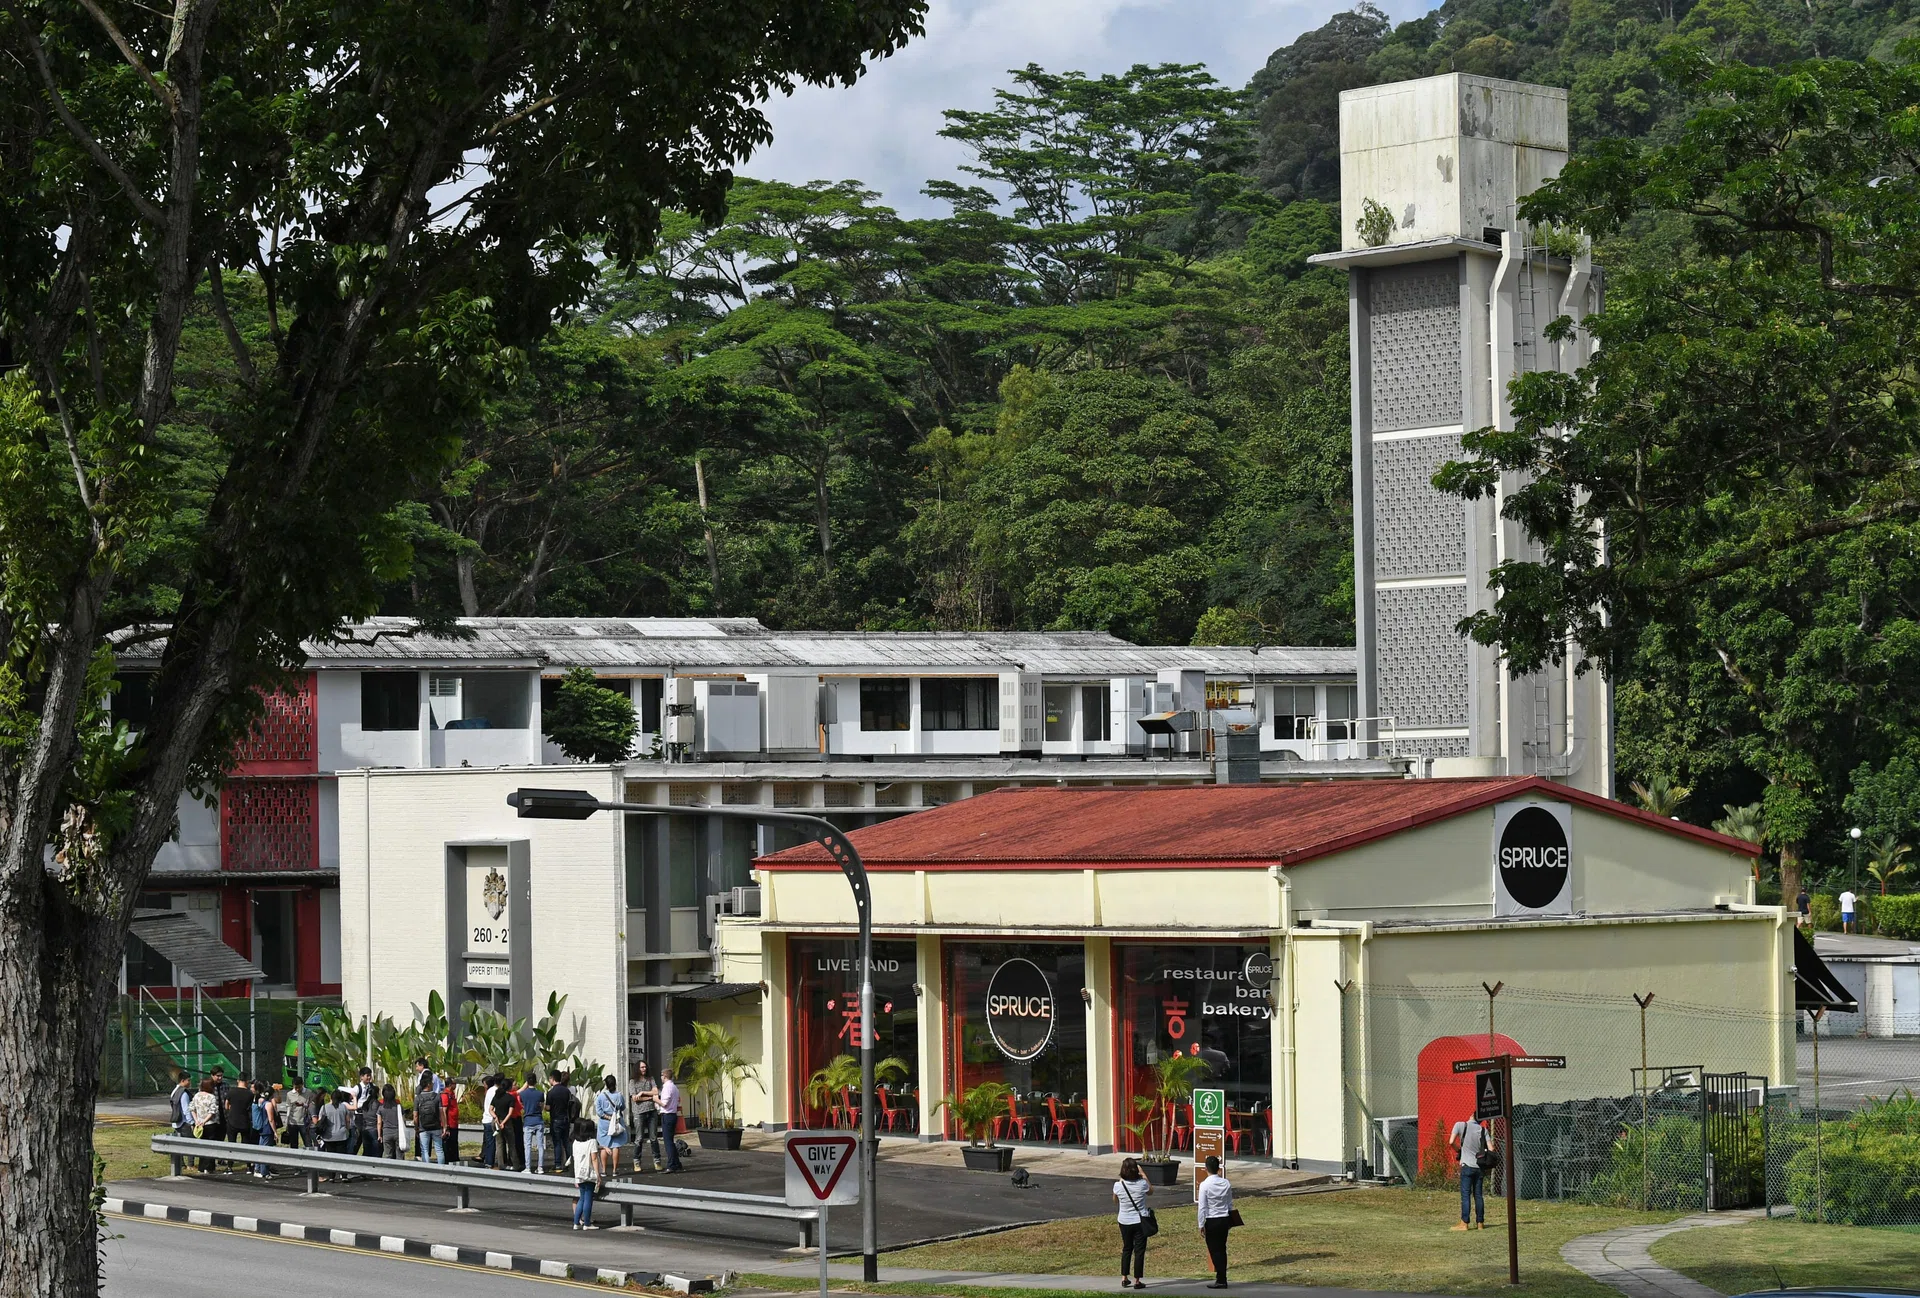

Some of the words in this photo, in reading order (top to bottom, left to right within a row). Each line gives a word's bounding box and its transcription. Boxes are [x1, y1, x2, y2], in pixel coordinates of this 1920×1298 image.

[1501, 847, 1567, 868] SPRUCE
[474, 927, 492, 943] 260
[501, 928, 510, 943] 2
[469, 966, 485, 975] UPPER
[486, 966, 493, 975] BT
[817, 958, 851, 971] LIVE
[1248, 965, 1273, 974] SPRUCE
[1235, 985, 1271, 998] bar
[989, 994, 1051, 1018] SPRUCE
[1202, 1001, 1272, 1019] bakery
[808, 1146, 836, 1161] GIVE
[813, 1164, 831, 1175] WAY
